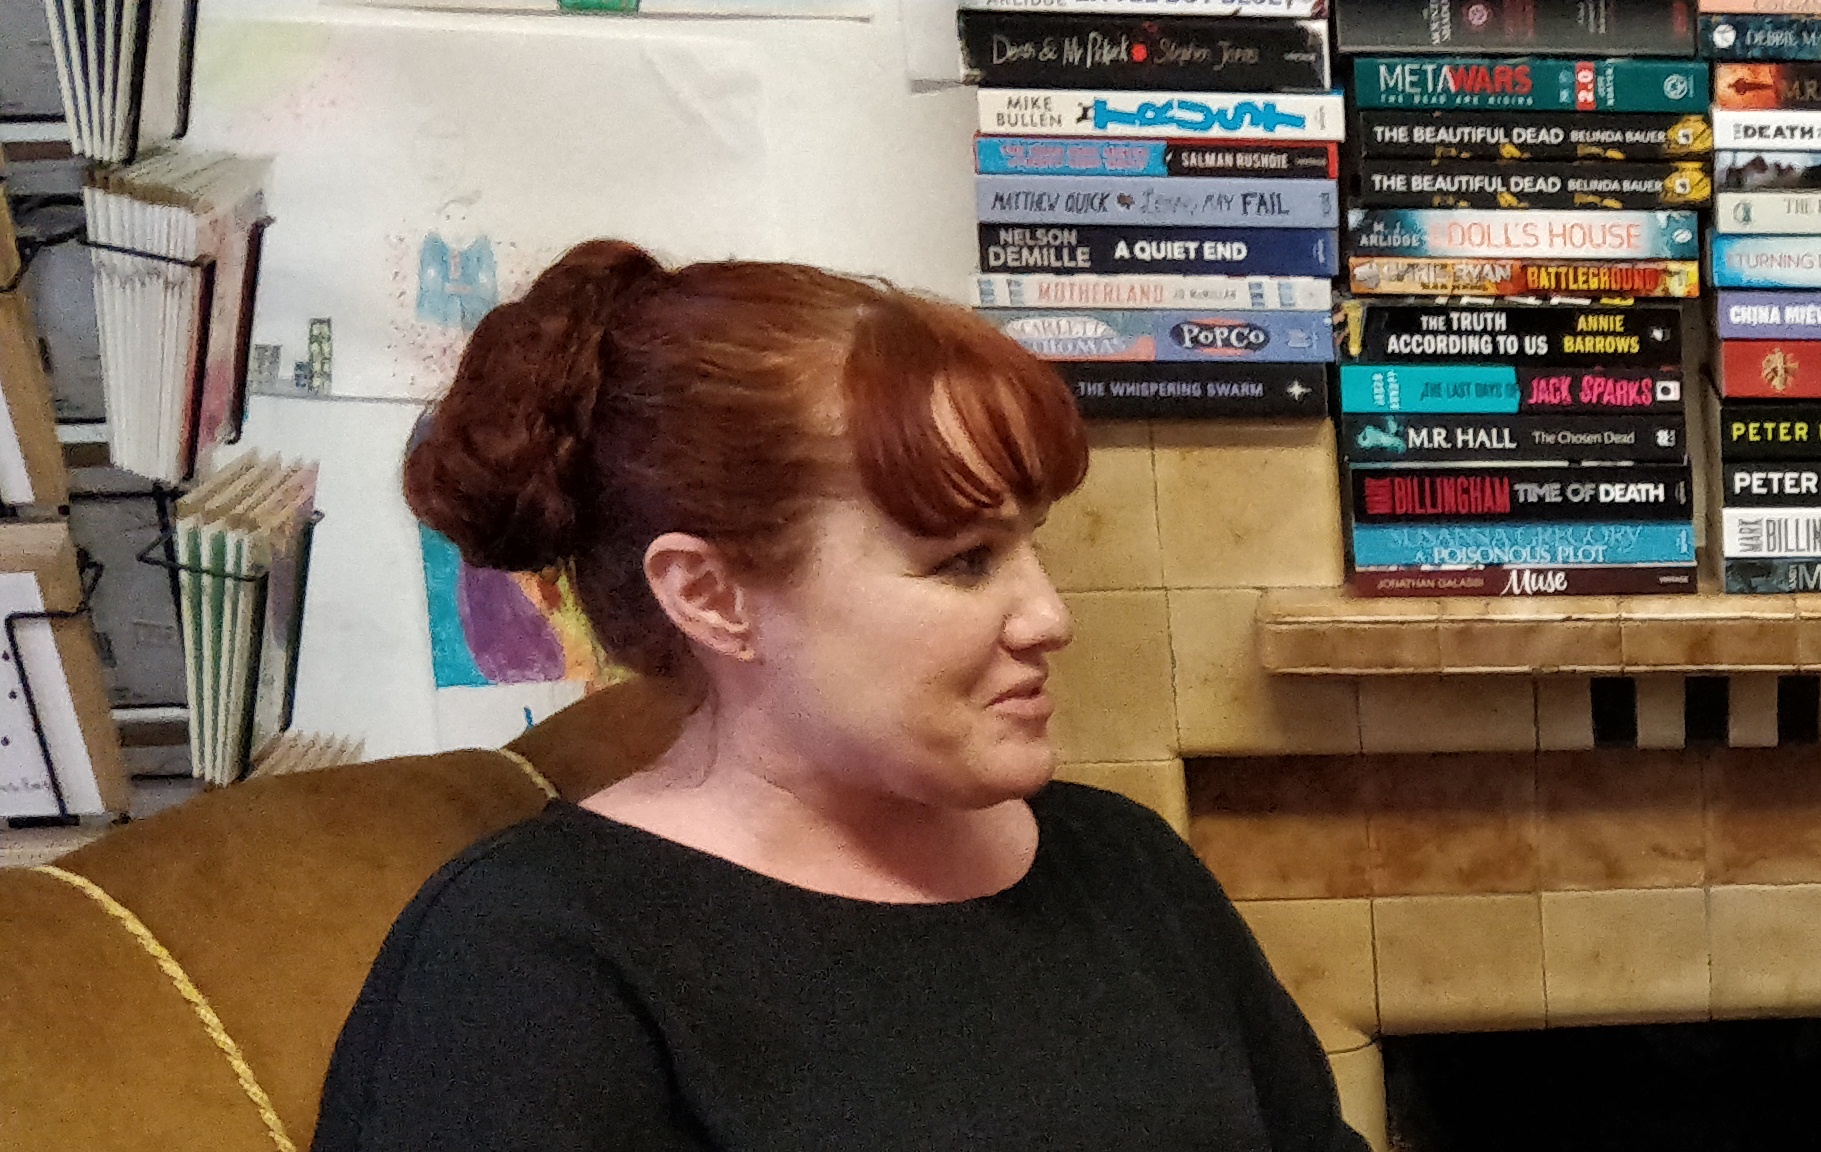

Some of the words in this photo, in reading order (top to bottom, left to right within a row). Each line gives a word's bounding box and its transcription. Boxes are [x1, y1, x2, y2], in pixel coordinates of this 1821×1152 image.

[1379, 64, 1534, 95] METAWARS
[1007, 96, 1054, 111] MIKE
[996, 111, 1063, 128] BULLEN
[1374, 126, 1409, 142] THE
[1413, 126, 1509, 144] BEAUTIFUL
[1512, 126, 1565, 145] DEAD
[1570, 129, 1622, 143] BELINDA
[1624, 130, 1667, 144] BAUER
[1743, 124, 1815, 140] DEATH
[1181, 152, 1235, 169] SALMAN
[1371, 175, 1407, 191] THE
[1410, 175, 1507, 193] BEAUTIFUL
[1510, 175, 1562, 193] DEAD
[1567, 179, 1620, 192] BELINDA
[1622, 180, 1662, 193] BAUER
[991, 191, 1060, 213] MATTHEW
[1064, 192, 1111, 214] QUICK
[1240, 192, 1290, 216] FAIL
[1784, 198, 1811, 215] THE
[999, 228, 1078, 245] NELSON
[1447, 221, 1540, 250] DOLL'S
[1548, 222, 1643, 250] HOUSE
[988, 246, 1092, 268] DEMILLE
[1114, 241, 1132, 261] A
[1134, 240, 1200, 262] QUIET
[1203, 241, 1248, 262] END
[1737, 253, 1815, 270] TURNING
[1526, 266, 1659, 292] BATTLEGROUND
[1420, 314, 1447, 331] THE
[1450, 311, 1507, 331] TRUTH
[1576, 314, 1625, 332] ANNIE
[1729, 305, 1781, 327] CHINA
[1387, 333, 1495, 355] ACCORDING
[1495, 334, 1519, 355] TO
[1524, 334, 1548, 355] US
[1563, 336, 1640, 354] BARROWS
[1077, 381, 1105, 397] THE
[1110, 382, 1202, 398] WHISPERING
[1207, 382, 1264, 397] SWARM
[1527, 377, 1573, 407] JACK
[1578, 376, 1654, 408] SPARKS
[1407, 427, 1453, 449] M.R.
[1457, 427, 1518, 449] HALL
[1532, 430, 1554, 445] The
[1556, 431, 1602, 445] Chosen
[1603, 431, 1636, 445] Dead
[1731, 422, 1808, 442] PETER
[1512, 483, 1563, 503] TIME
[1564, 483, 1598, 503] OF
[1599, 483, 1666, 503] DEATH
[1733, 472, 1818, 495] PETER
[1394, 475, 1511, 515] BILLINGHAM
[1433, 545, 1551, 564] POISONOUS
[1557, 545, 1608, 563] PLOT
[1500, 569, 1569, 596] Muse
